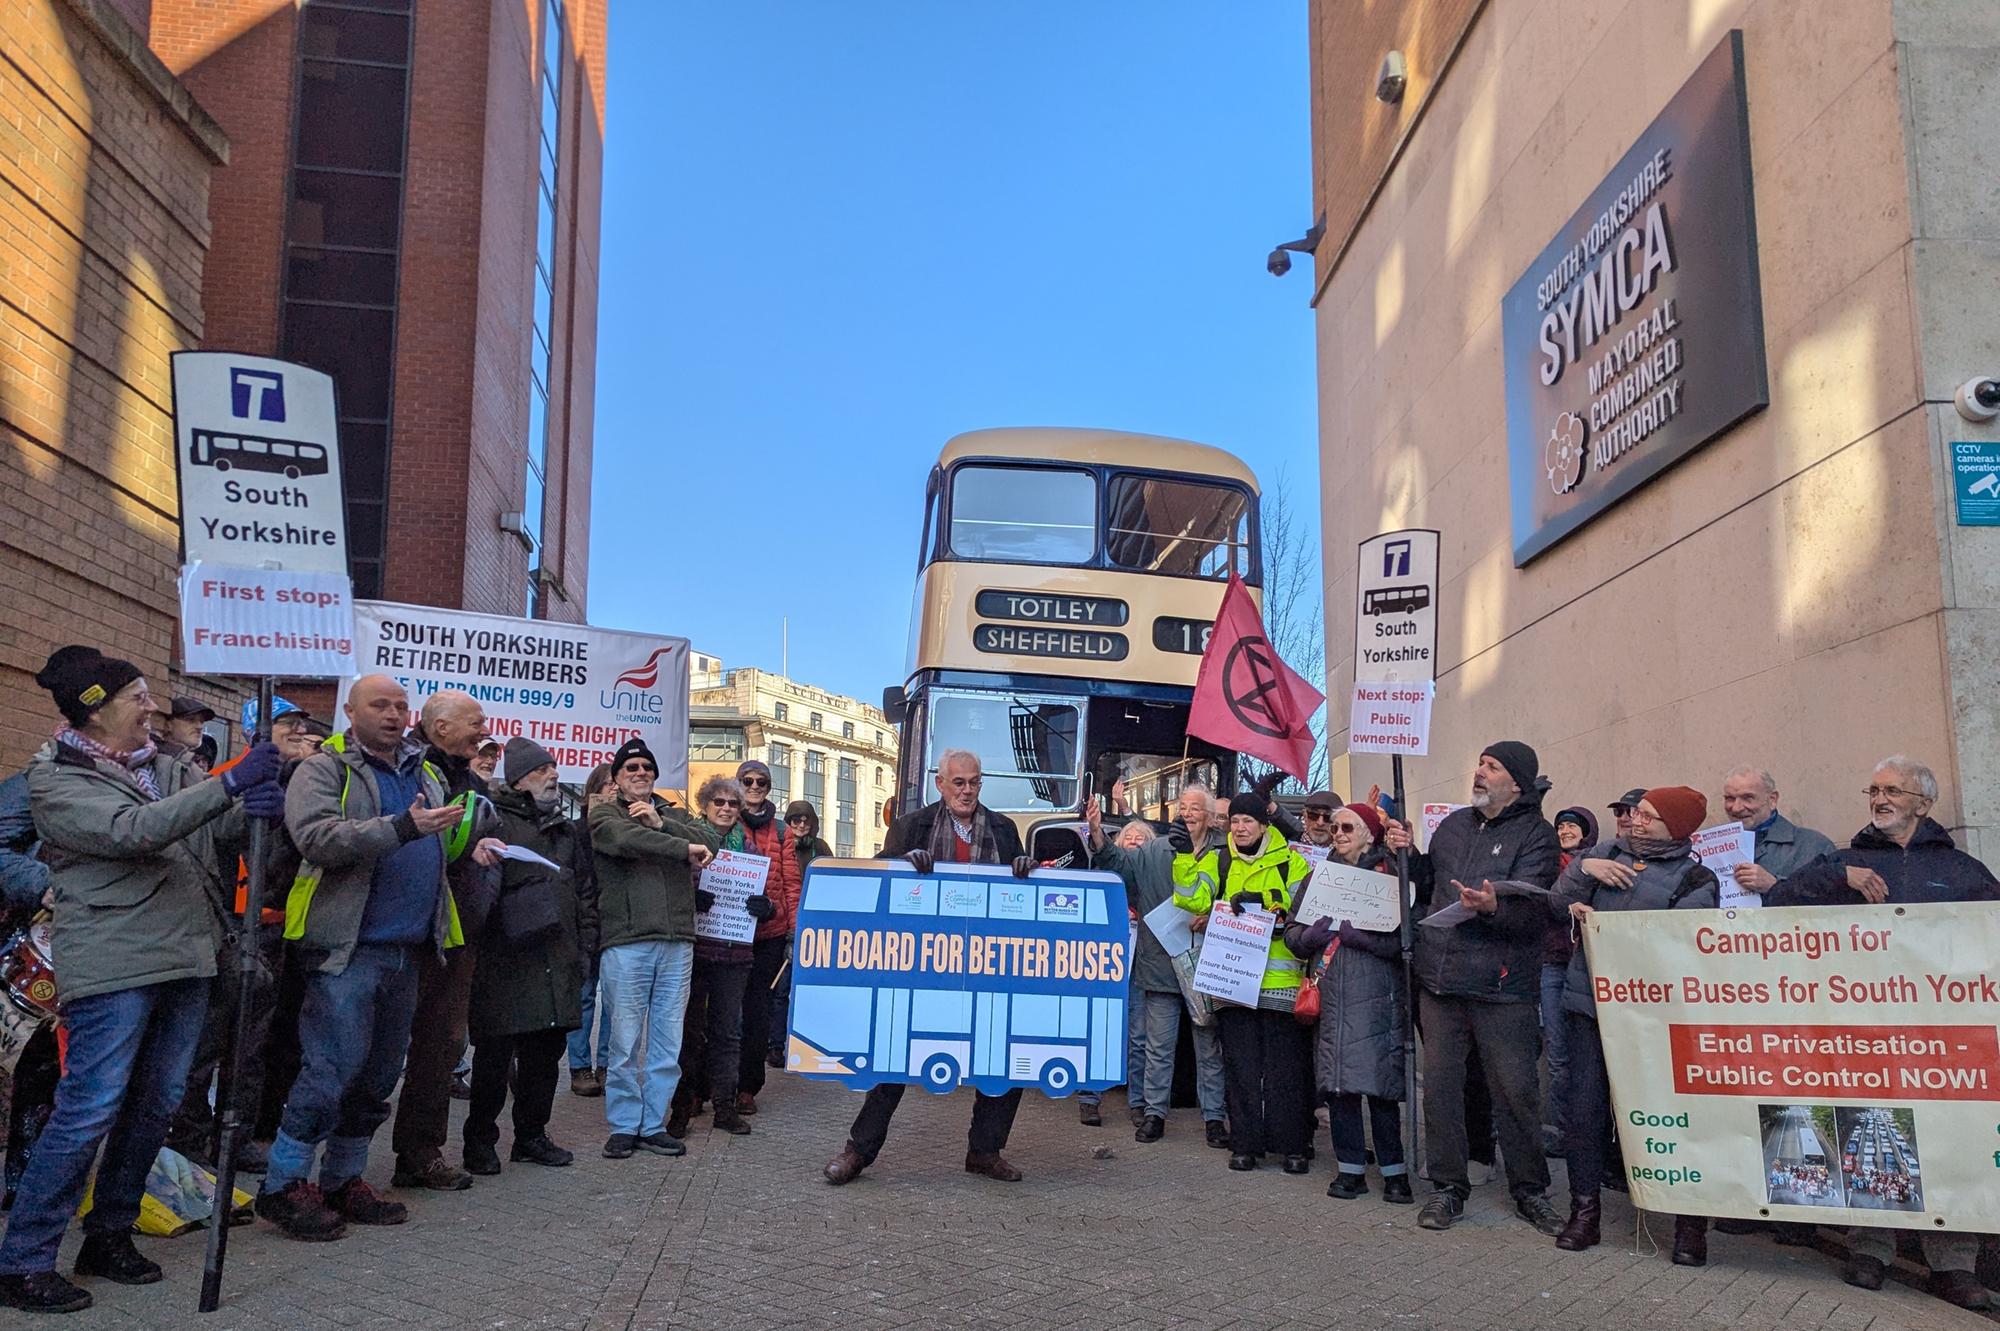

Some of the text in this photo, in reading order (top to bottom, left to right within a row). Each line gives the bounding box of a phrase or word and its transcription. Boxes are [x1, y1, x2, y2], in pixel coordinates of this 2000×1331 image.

[1537, 147, 1668, 312] SOUTH YORKSHIRE
[1539, 201, 1672, 387] SYMCA
[1588, 298, 1677, 396] MAYORAL
[1590, 338, 1677, 434] COMBINED
[1592, 378, 1679, 472] AUTHORITY
[1956, 445, 1982, 454] CCTV
[1957, 455, 1995, 463] cameras
[224, 480, 309, 508] South
[200, 516, 337, 546] Yorkshire
[202, 580, 341, 609] First stop:
[1007, 597, 1098, 621] TOTLEY
[1375, 620, 1417, 638] South
[193, 628, 352, 655] Franchising
[379, 620, 589, 662] SOUTH YORKSHIRE
[987, 629, 1113, 655] SHEFFIELD
[375, 645, 588, 686] RETIRED MEMBERS
[1363, 645, 1430, 664] Yorkshire
[519, 688, 575, 710] 999/9
[783, 682, 849, 711] EXCHANGE
[1357, 688, 1425, 704] Next stop:
[1370, 712, 1411, 726] Public
[528, 720, 567, 742] THE
[571, 724, 641, 746] RIGHTS
[1353, 733, 1420, 748] ownership
[549, 746, 618, 768] MBERS
[1692, 840, 1739, 859] elebrate!
[708, 863, 762, 880] Celebrate!
[710, 876, 755, 889] South Yorks
[707, 884, 732, 894] moves
[1317, 866, 1400, 900] ACTIVIS
[715, 900, 748, 913] nchising
[722, 894, 740, 903] road
[1001, 892, 1025, 903] TUC
[697, 918, 749, 931] public control
[722, 913, 752, 923] towards
[1214, 916, 1266, 936] Celebrate!
[706, 927, 720, 936] our
[1207, 931, 1267, 953] Welcome franchising
[1696, 924, 1892, 960] Campaign for
[799, 928, 1125, 982] ON BOARD FOR BETTER BUSES
[1200, 959, 1221, 970] Ensure
[1221, 964, 1233, 973] bus
[1225, 952, 1242, 962] BUT
[1195, 981, 1233, 996] safeguarded
[1196, 970, 1240, 987] conditions are
[1595, 974, 2000, 1004] Better Buses for South York
[1698, 1033, 1753, 1054] End
[1762, 1033, 1946, 1056] Privatisation
[1686, 1065, 1988, 1090] Public Control NOW!
[1629, 1109, 1690, 1129] Good
[1645, 1137, 1677, 1155] for
[1631, 1164, 1702, 1186] people
